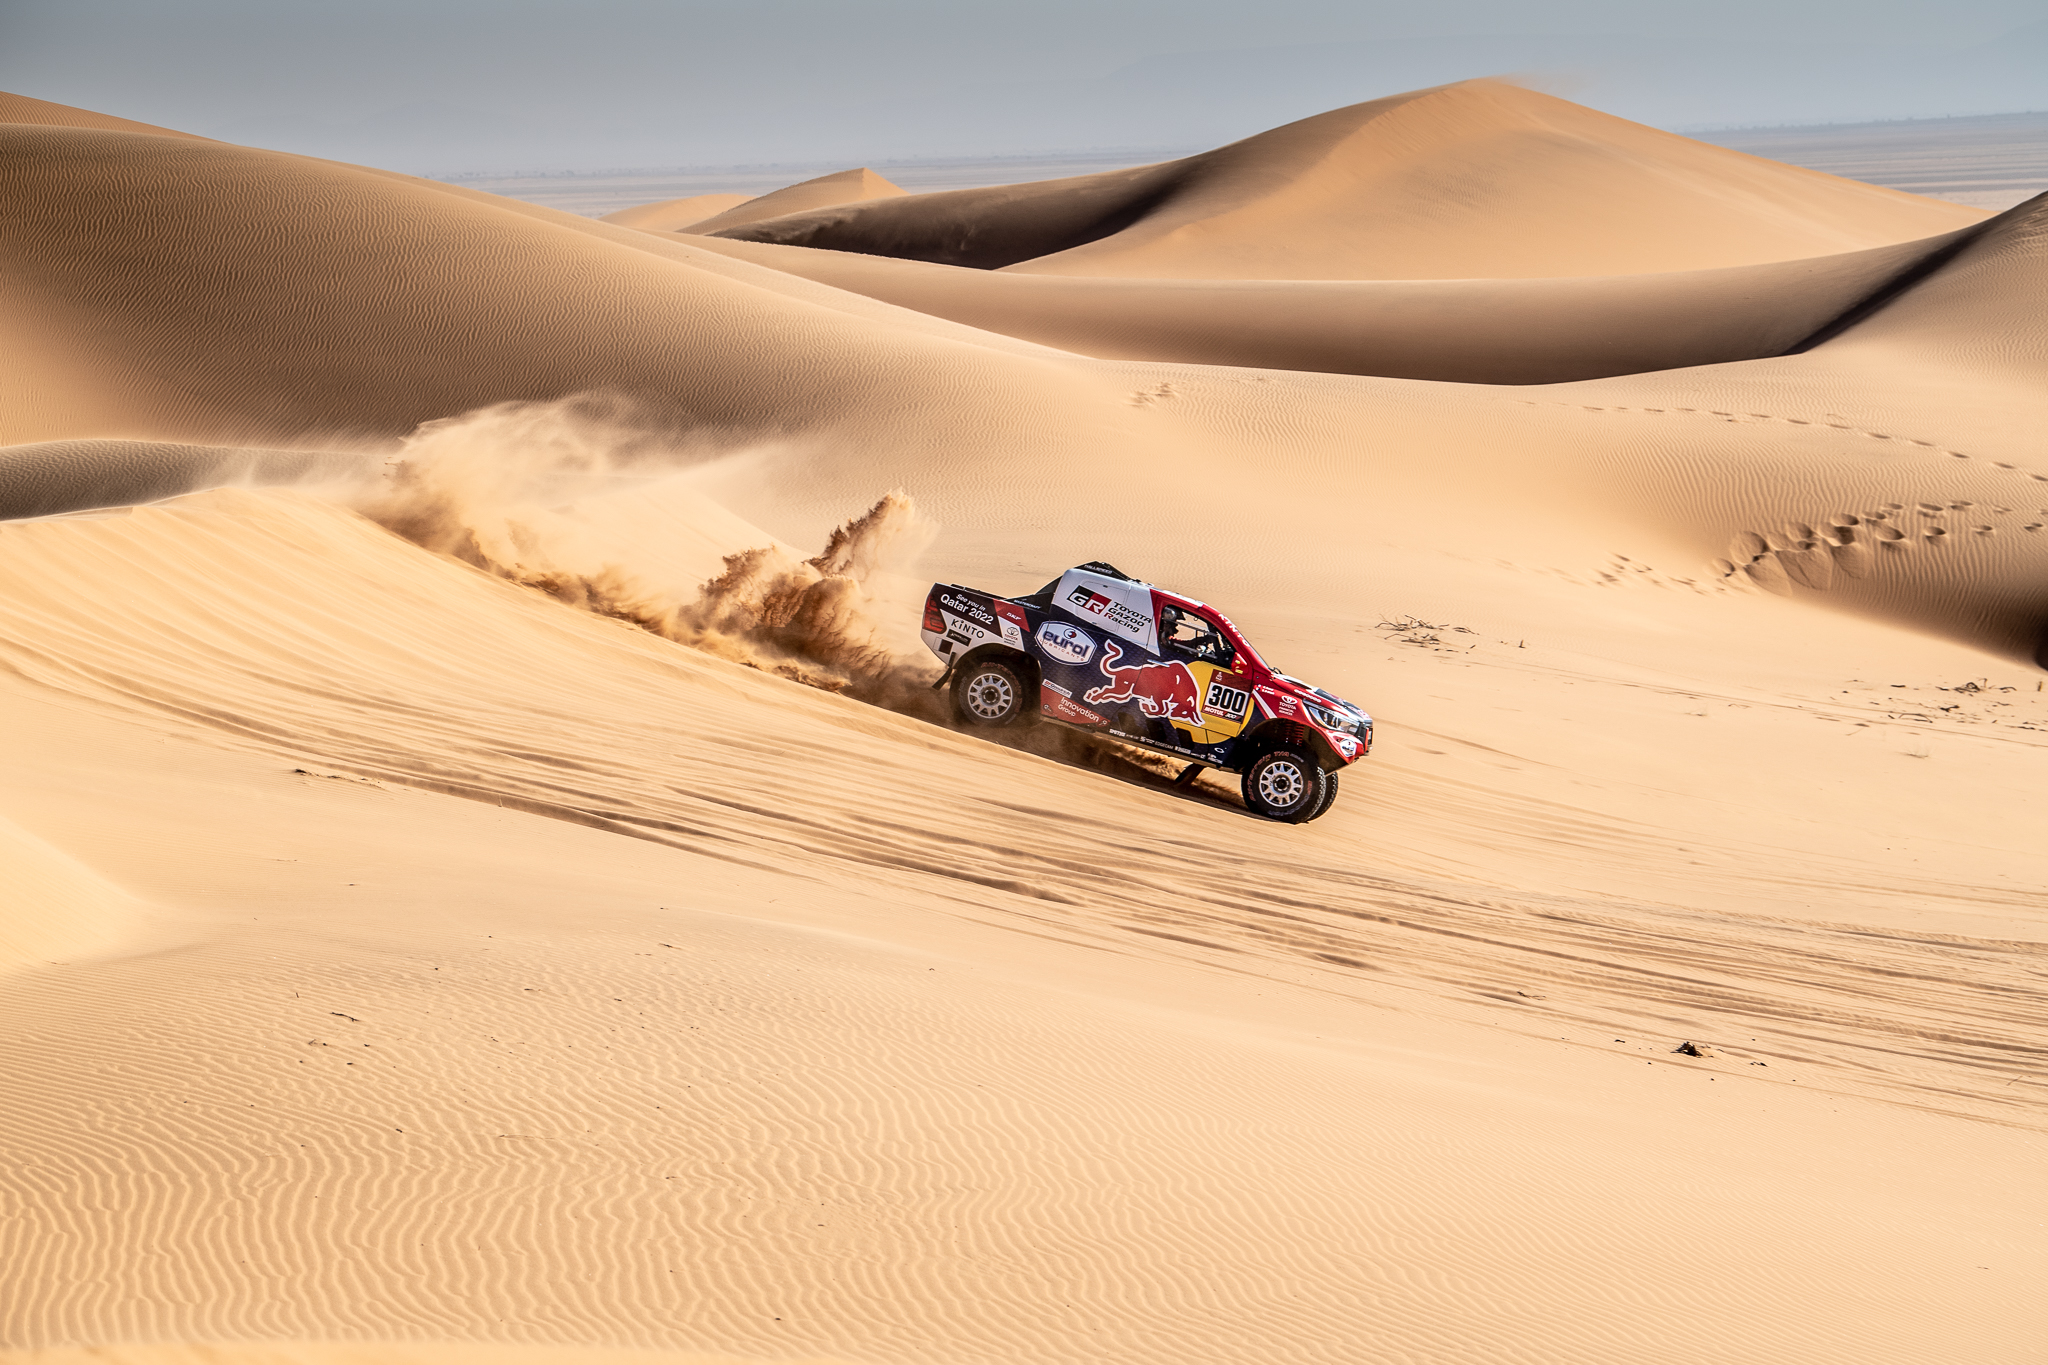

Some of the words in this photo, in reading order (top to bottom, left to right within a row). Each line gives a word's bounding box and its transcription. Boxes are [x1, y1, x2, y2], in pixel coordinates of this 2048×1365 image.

[940, 593, 969, 613] Qatar
[968, 607, 994, 625] 2022
[956, 593, 968, 603] See
[968, 601, 980, 610] you
[1068, 592, 1105, 614] GR
[1113, 601, 1152, 624] TOYOTA
[1104, 612, 1140, 633] Racing
[1108, 607, 1145, 627] GAZOO
[1040, 639, 1085, 661] LUBRICANTS
[1043, 630, 1090, 658] eurol
[1060, 697, 1100, 722] Innovation
[1208, 685, 1246, 713] 300
[1279, 702, 1297, 710] TOYOTA
[1057, 704, 1076, 717] Group
[1204, 706, 1225, 716] MOTUL
